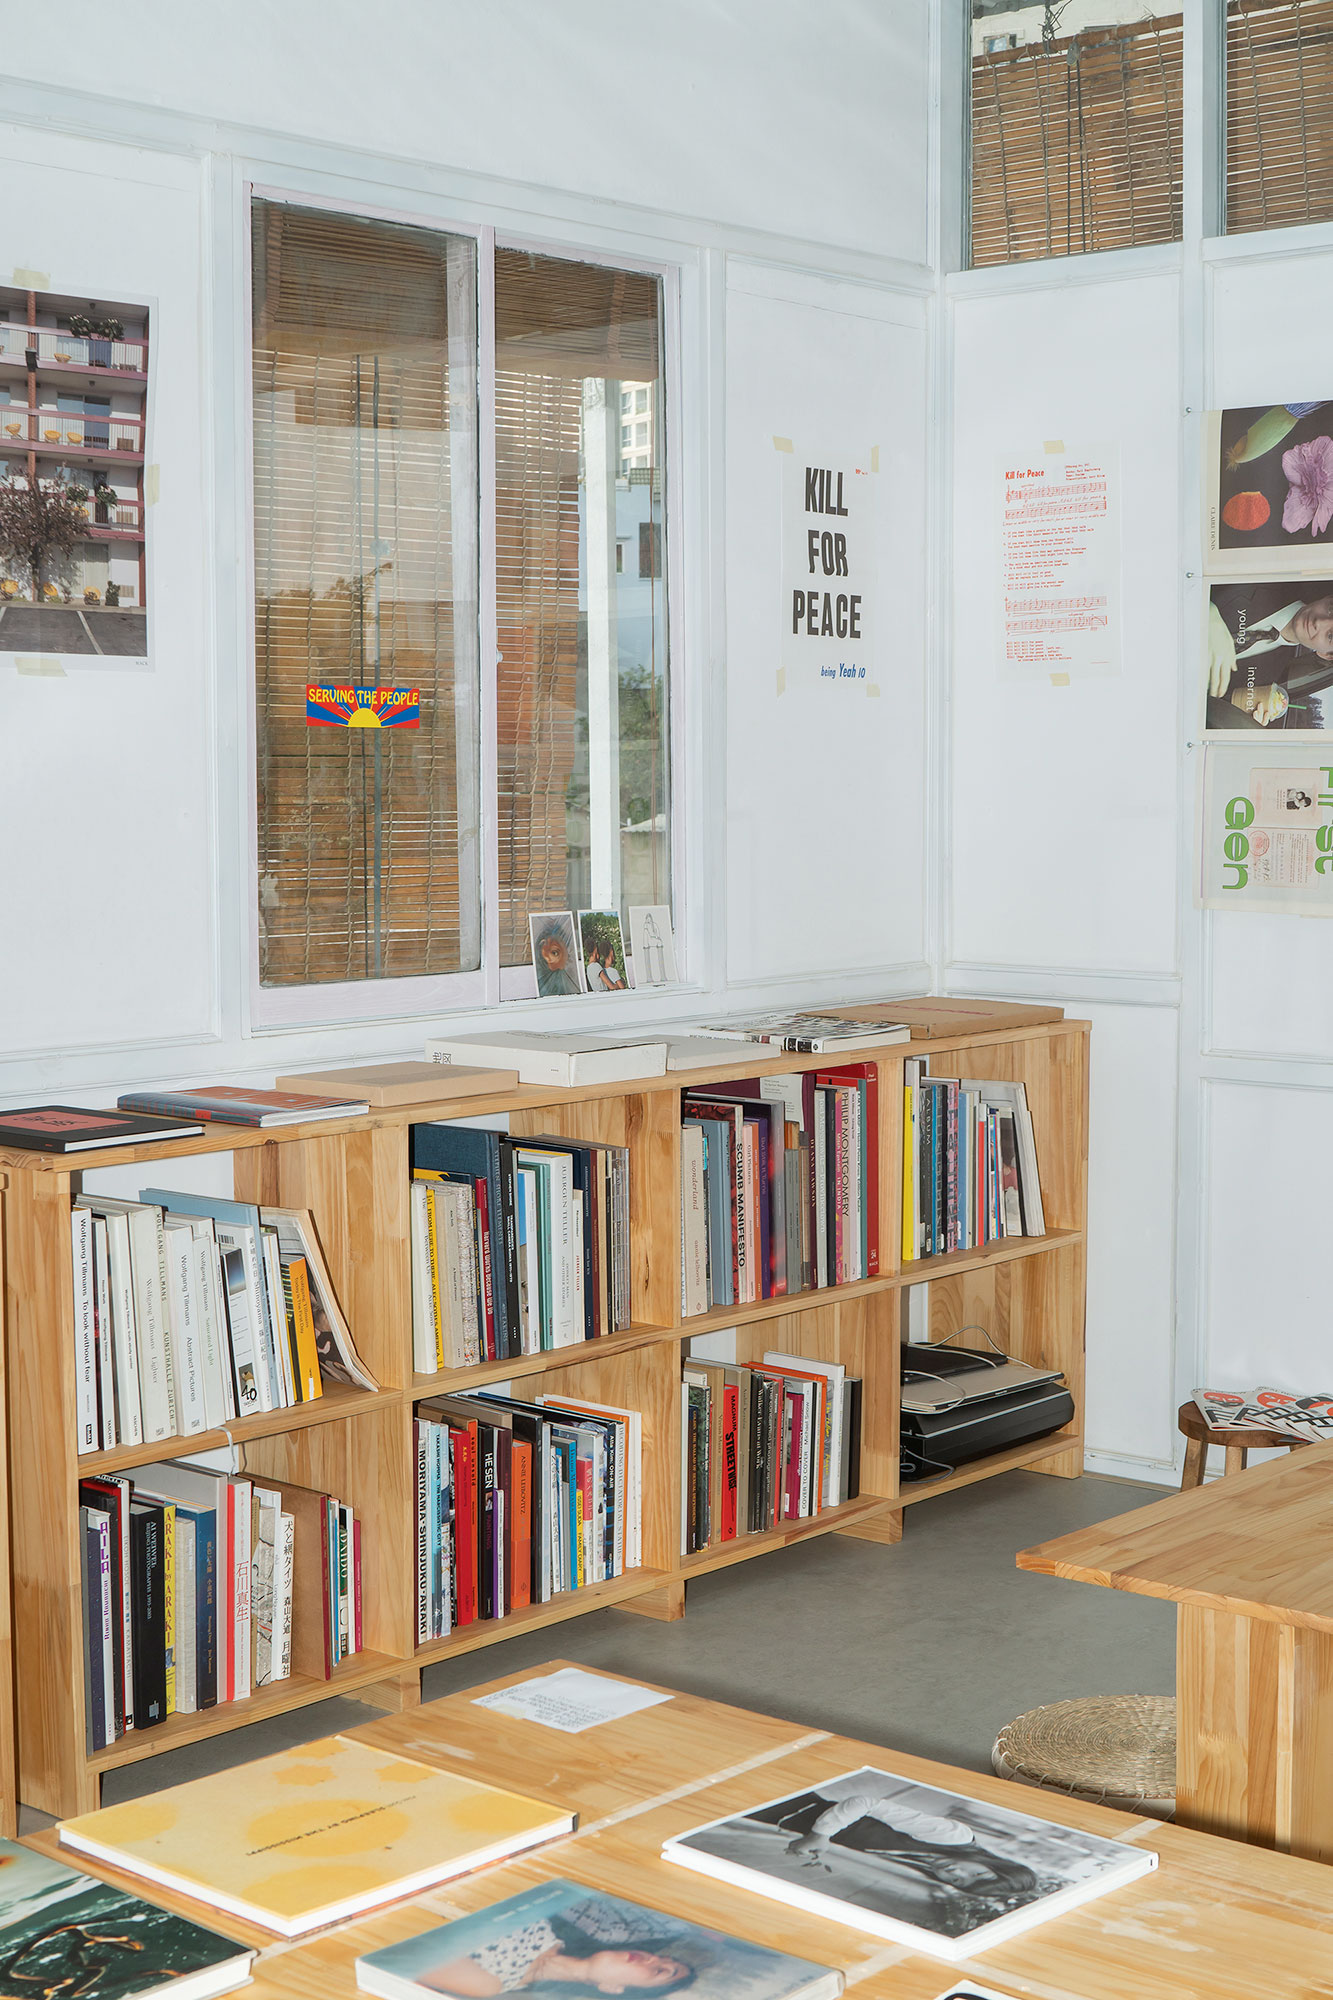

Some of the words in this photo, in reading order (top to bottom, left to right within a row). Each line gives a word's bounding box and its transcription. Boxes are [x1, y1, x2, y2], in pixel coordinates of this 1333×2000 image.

[805, 466, 848, 516] KILL
[1005, 470, 1015, 481] Kill
[1016, 470, 1025, 479] for
[1026, 469, 1044, 478] Peace
[808, 530, 848, 576] FOR
[792, 589, 862, 639] PEACE
[1236, 609, 1247, 644] young
[821, 665, 836, 679] being
[839, 663, 856, 678] Yeah
[1246, 666, 1257, 711] internet
[308, 688, 355, 704] SERVING
[356, 690, 378, 705] THE
[380, 691, 419, 706] PEOPLE
[1222, 797, 1255, 890] Gen
[691, 1159, 699, 1210] wonderland
[736, 1142, 744, 1190] SCUMB
[484, 1231, 492, 1254] Harvard
[737, 1193, 745, 1267] MANIFESTO
[429, 1248, 434, 1259] TO
[83, 1300, 89, 1310] To
[299, 1274, 307, 1302] Wolfgang
[486, 1297, 493, 1307] We
[487, 1307, 494, 1315] Do
[164, 1332, 173, 1384] KUNSTHALLE
[617, 1426, 625, 1466] DECODING
[725, 1431, 737, 1491] STREETWISE
[756, 1441, 762, 1449] at
[803, 1476, 808, 1485] TO
[150, 1521, 157, 1533] AI
[99, 1521, 110, 1574] AILA
[283, 1521, 294, 1590] 犬と網タイツ
[340, 1532, 348, 1578] DAIDO
[236, 1560, 250, 1623] 石川真生
[282, 1597, 292, 1635] 森山大道
